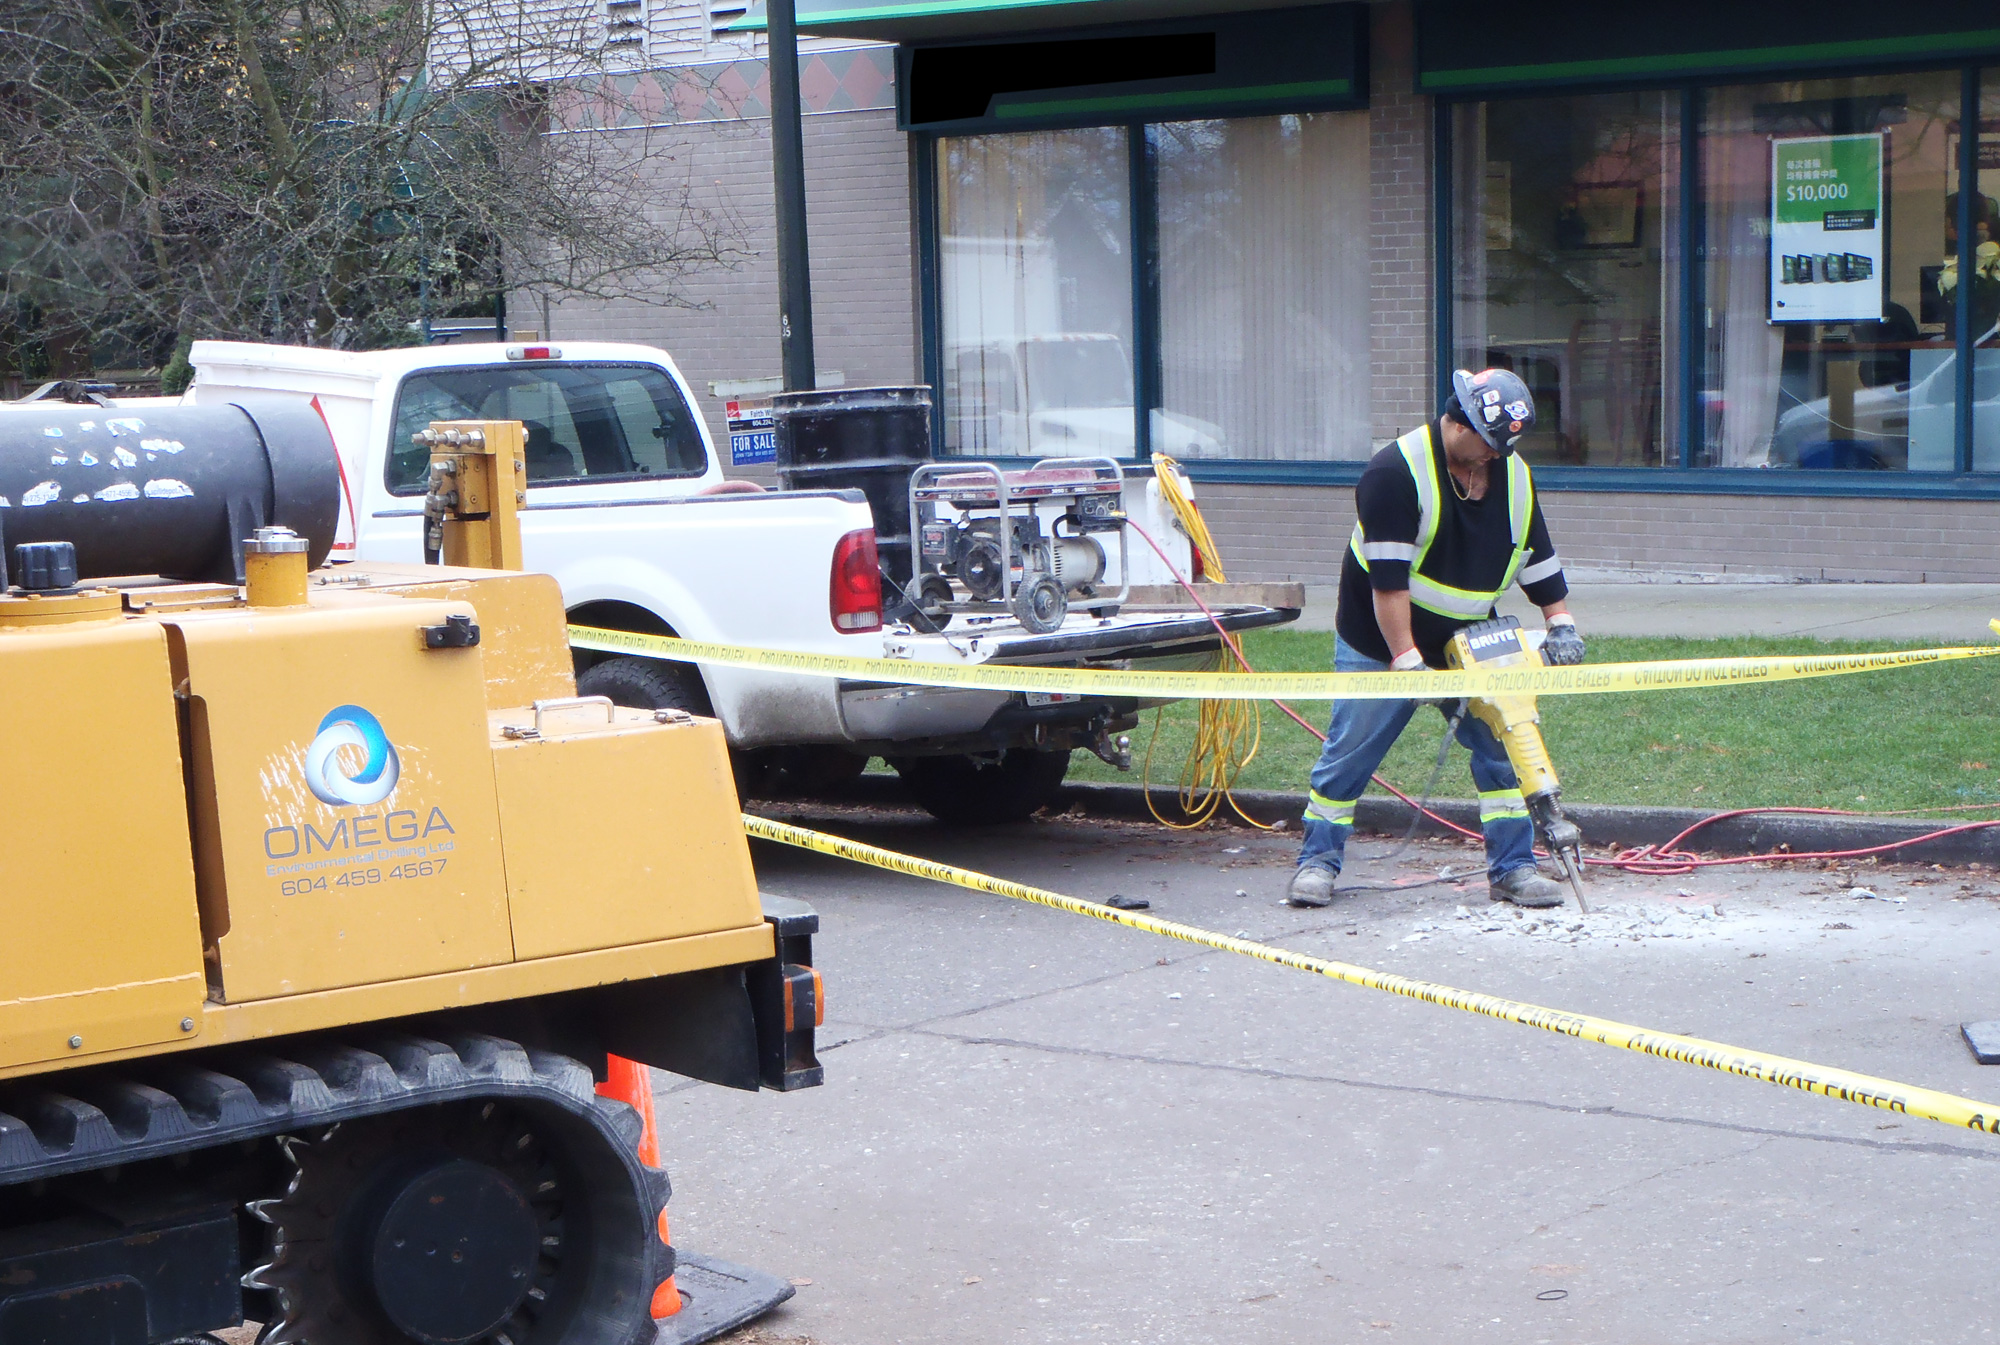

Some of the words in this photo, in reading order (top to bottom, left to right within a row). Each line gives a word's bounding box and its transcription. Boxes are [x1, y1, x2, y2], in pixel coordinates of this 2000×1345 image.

[1786, 183, 1849, 202] $10,000
[733, 436, 751, 452] FOR
[754, 434, 776, 450] SALE
[1469, 630, 1516, 650] BRUTE
[263, 806, 456, 859] OMEGA
[265, 851, 374, 877] Environmental
[377, 843, 427, 861] Drilling
